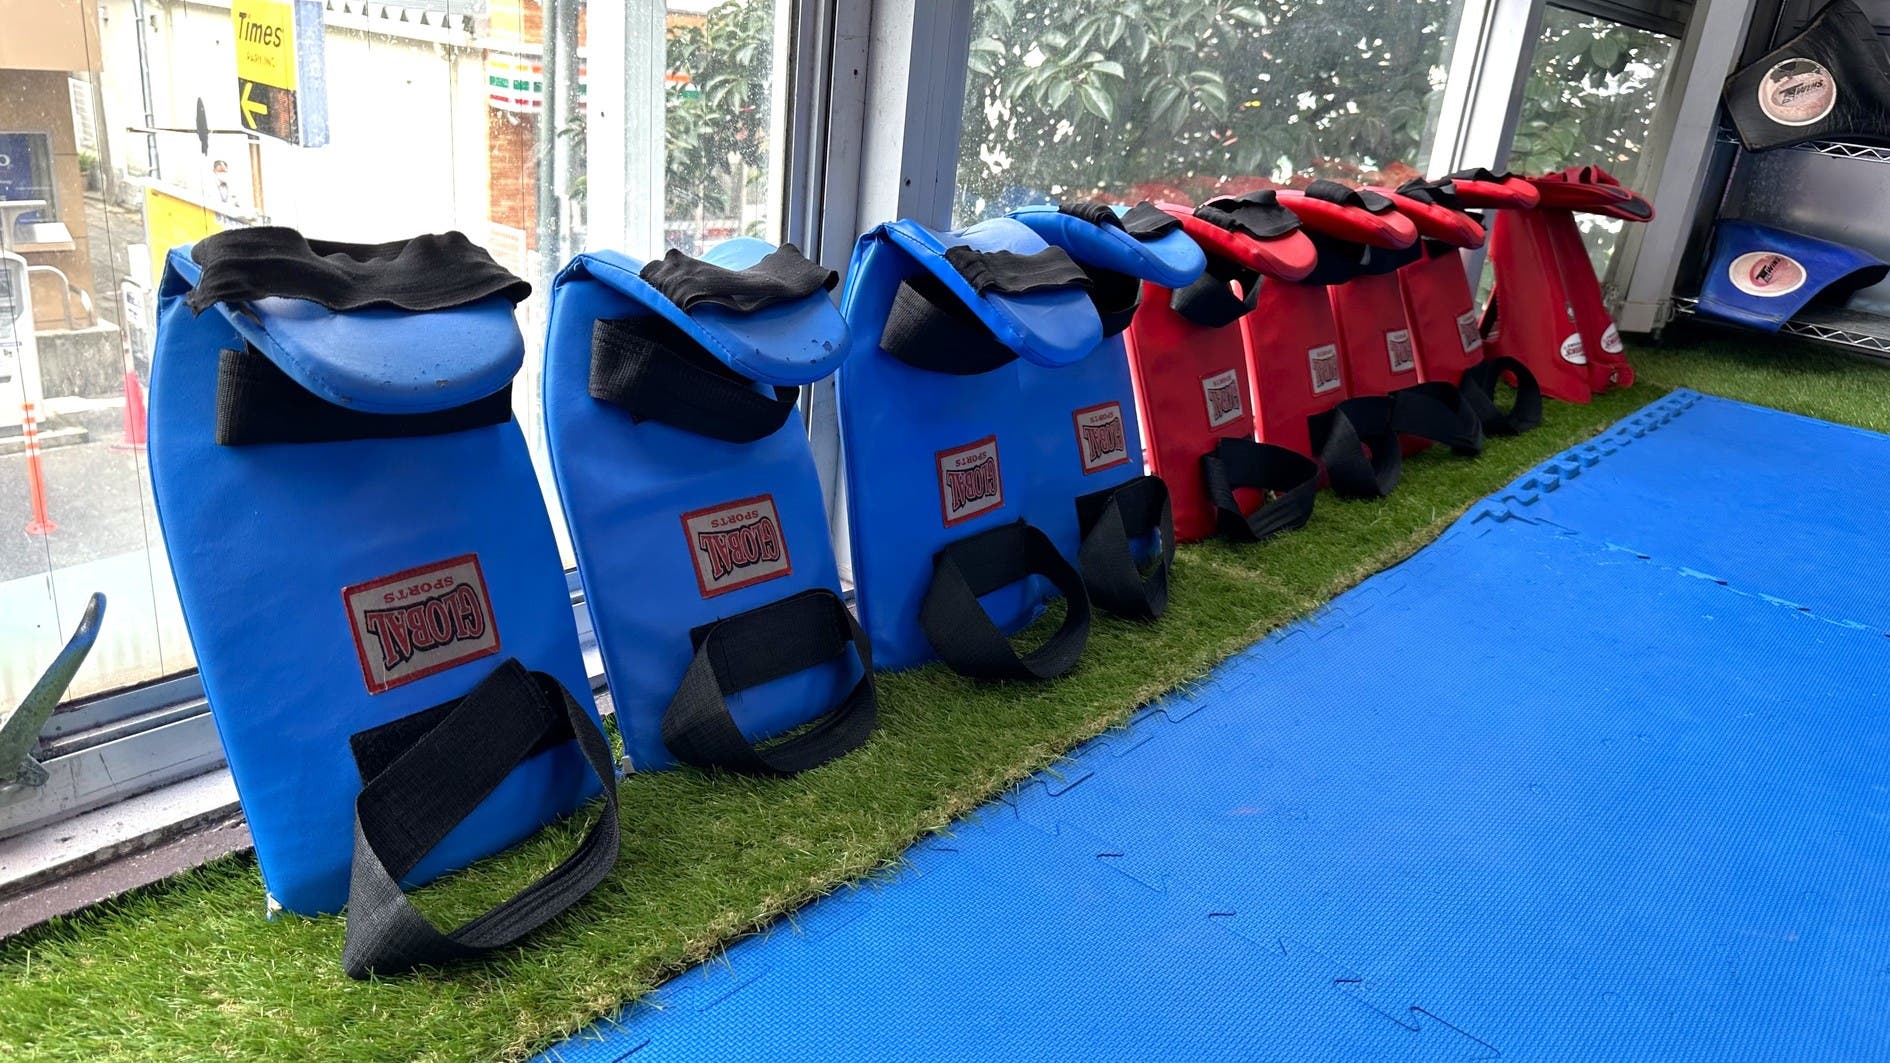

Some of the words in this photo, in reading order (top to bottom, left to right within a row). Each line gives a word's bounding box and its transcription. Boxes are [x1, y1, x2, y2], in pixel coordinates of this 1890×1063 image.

[238, 12, 284, 48] Times
[955, 451, 988, 467] SPORTS
[946, 456, 997, 512] GLOBAL
[711, 510, 759, 528] SPORTS
[698, 516, 780, 581] GLOBAL
[384, 575, 454, 603] SPORTS
[364, 583, 485, 671] GLOBAL
